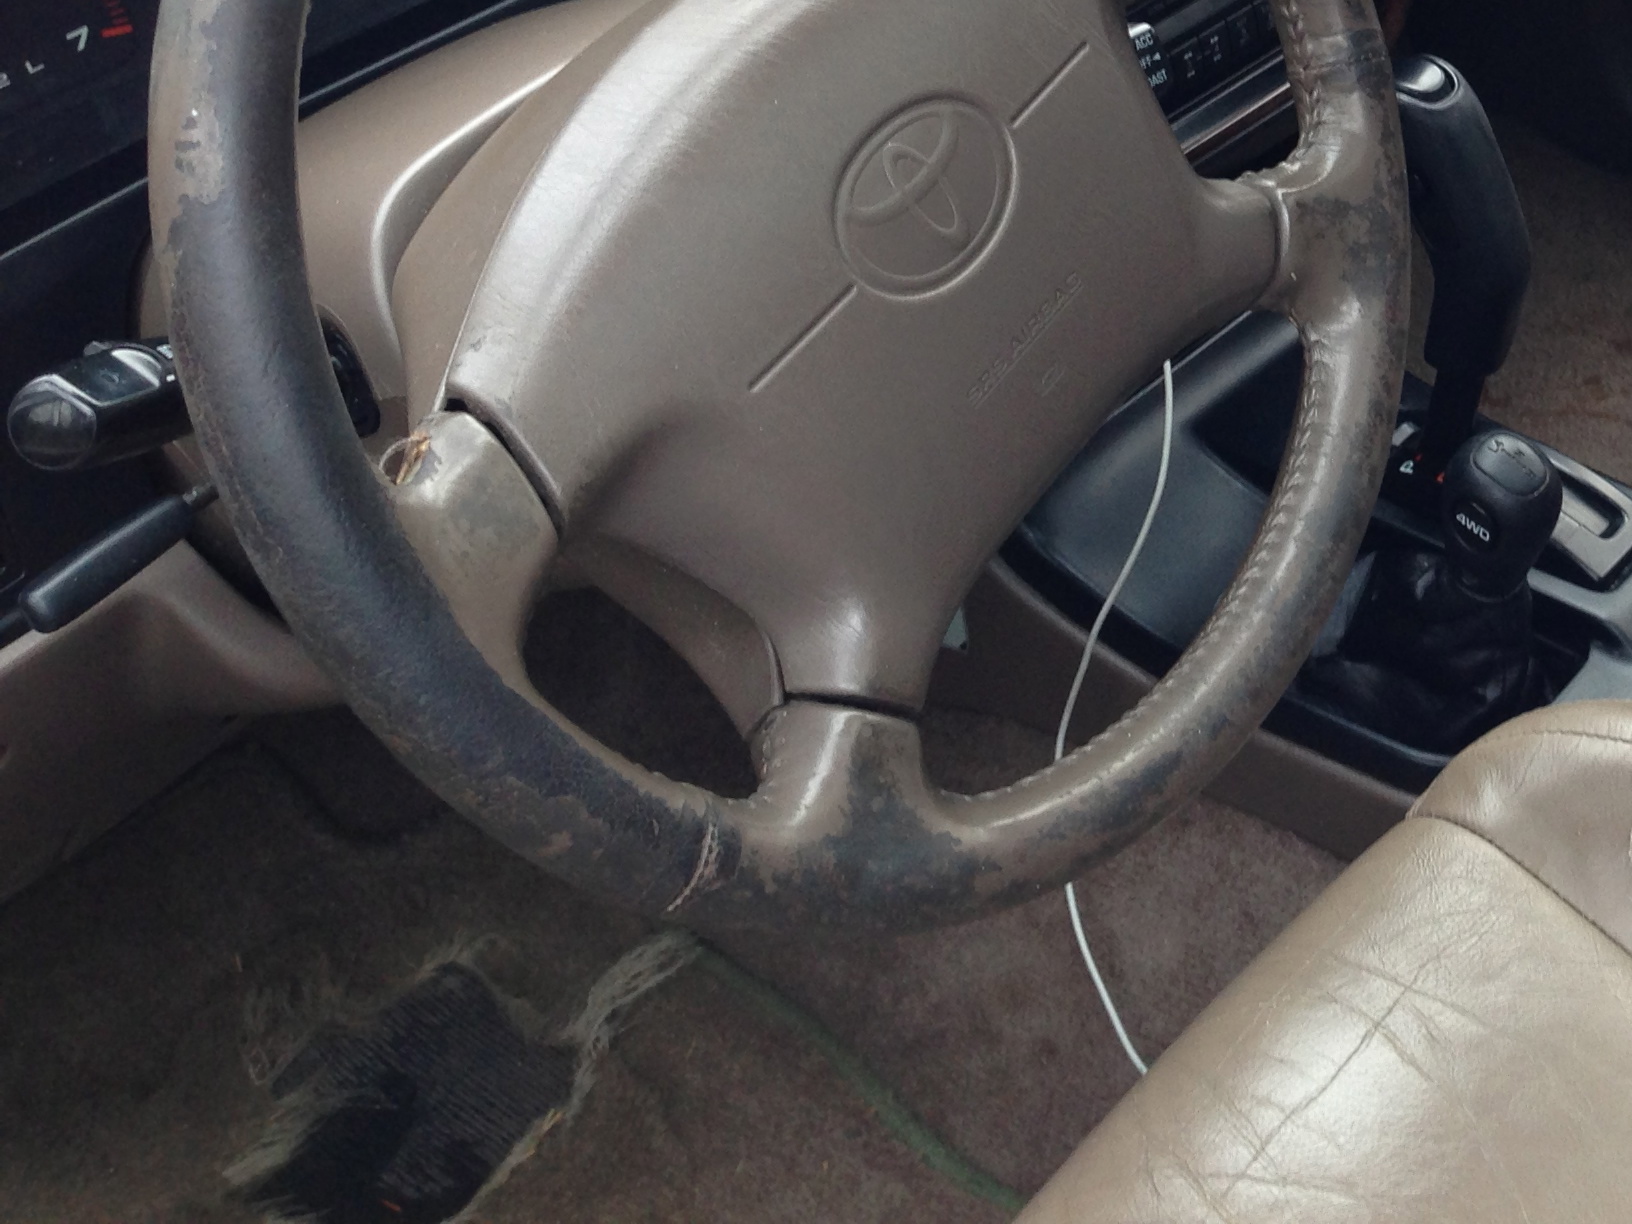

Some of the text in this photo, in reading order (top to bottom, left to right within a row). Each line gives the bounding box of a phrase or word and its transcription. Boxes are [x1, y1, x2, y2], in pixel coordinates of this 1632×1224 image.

[66, 25, 89, 52] 7
[25, 60, 45, 75] L
[1455, 512, 1490, 542] 4WD
